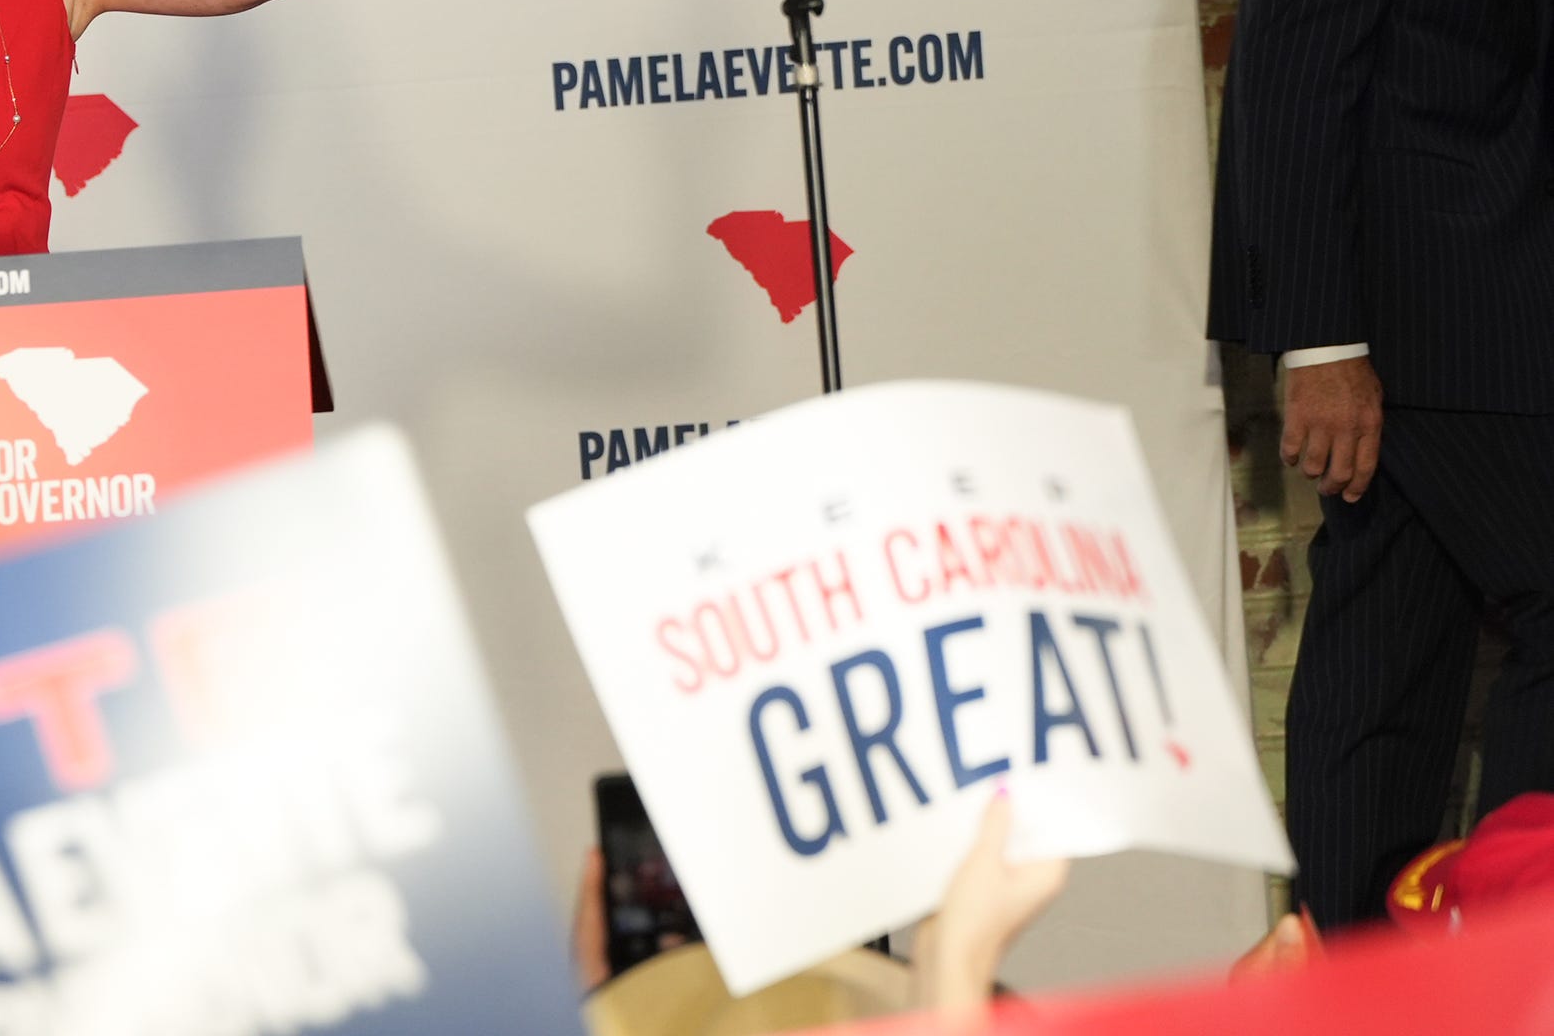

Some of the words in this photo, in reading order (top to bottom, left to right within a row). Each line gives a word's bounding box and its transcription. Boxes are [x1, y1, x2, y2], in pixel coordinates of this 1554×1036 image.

[552, 31, 984, 111] PAMELAEVETE.COM
[654, 549, 864, 697] SOUTH
[883, 514, 1152, 606] CAROLINA
[749, 612, 1192, 856] GREAT!
